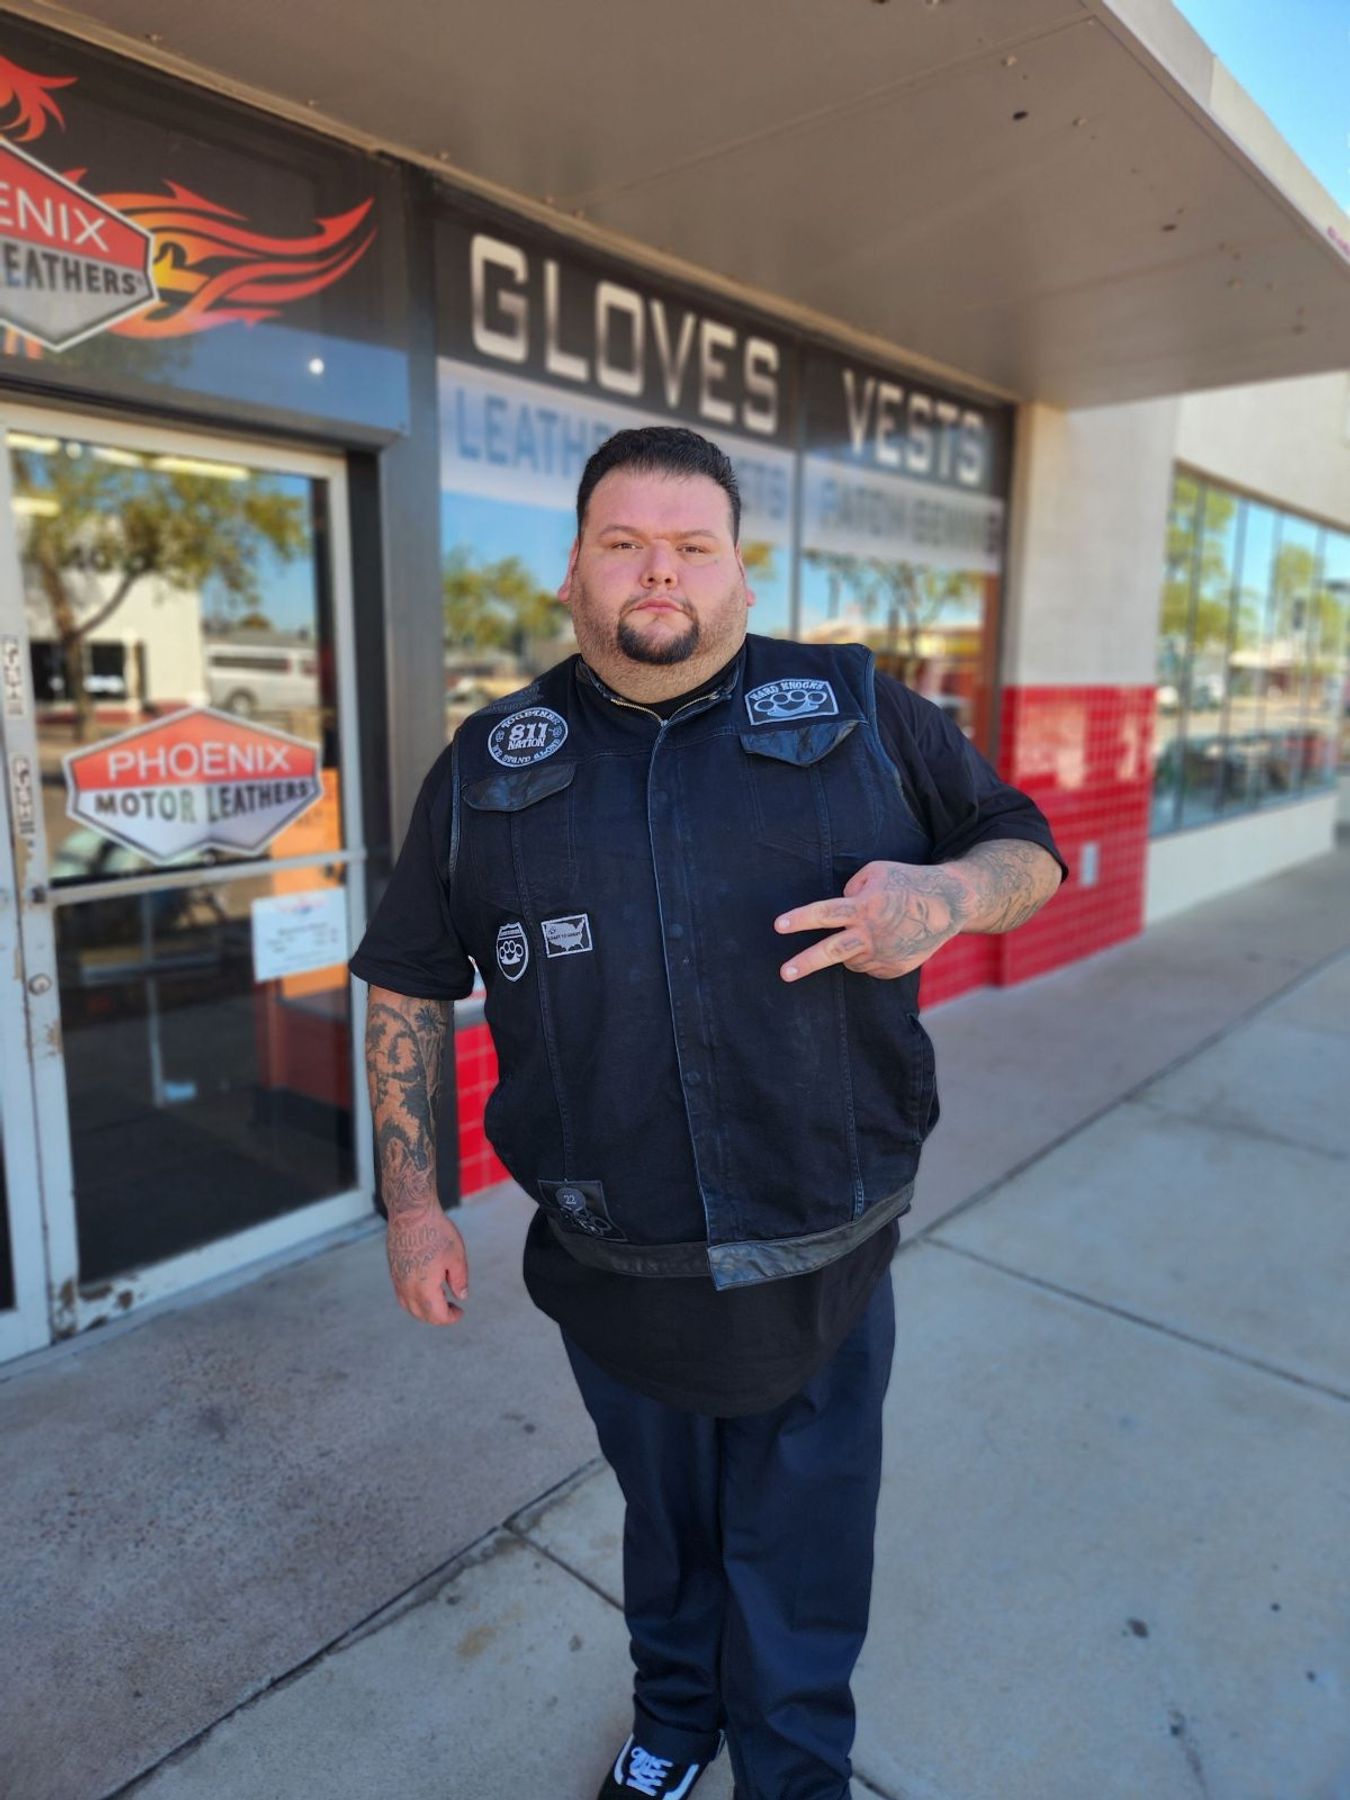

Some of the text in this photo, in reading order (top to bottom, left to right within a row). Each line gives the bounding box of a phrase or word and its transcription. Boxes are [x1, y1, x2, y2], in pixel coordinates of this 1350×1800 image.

[471, 234, 779, 435] GLOVES
[843, 368, 984, 487] VESTS
[750, 681, 824, 700] HARD KNOCKS
[507, 738, 545, 750] NATION
[509, 722, 548, 741] 811
[108, 742, 292, 781] PHOENIX
[95, 789, 196, 823] MOTOR
[207, 781, 310, 823] LEATHERS
